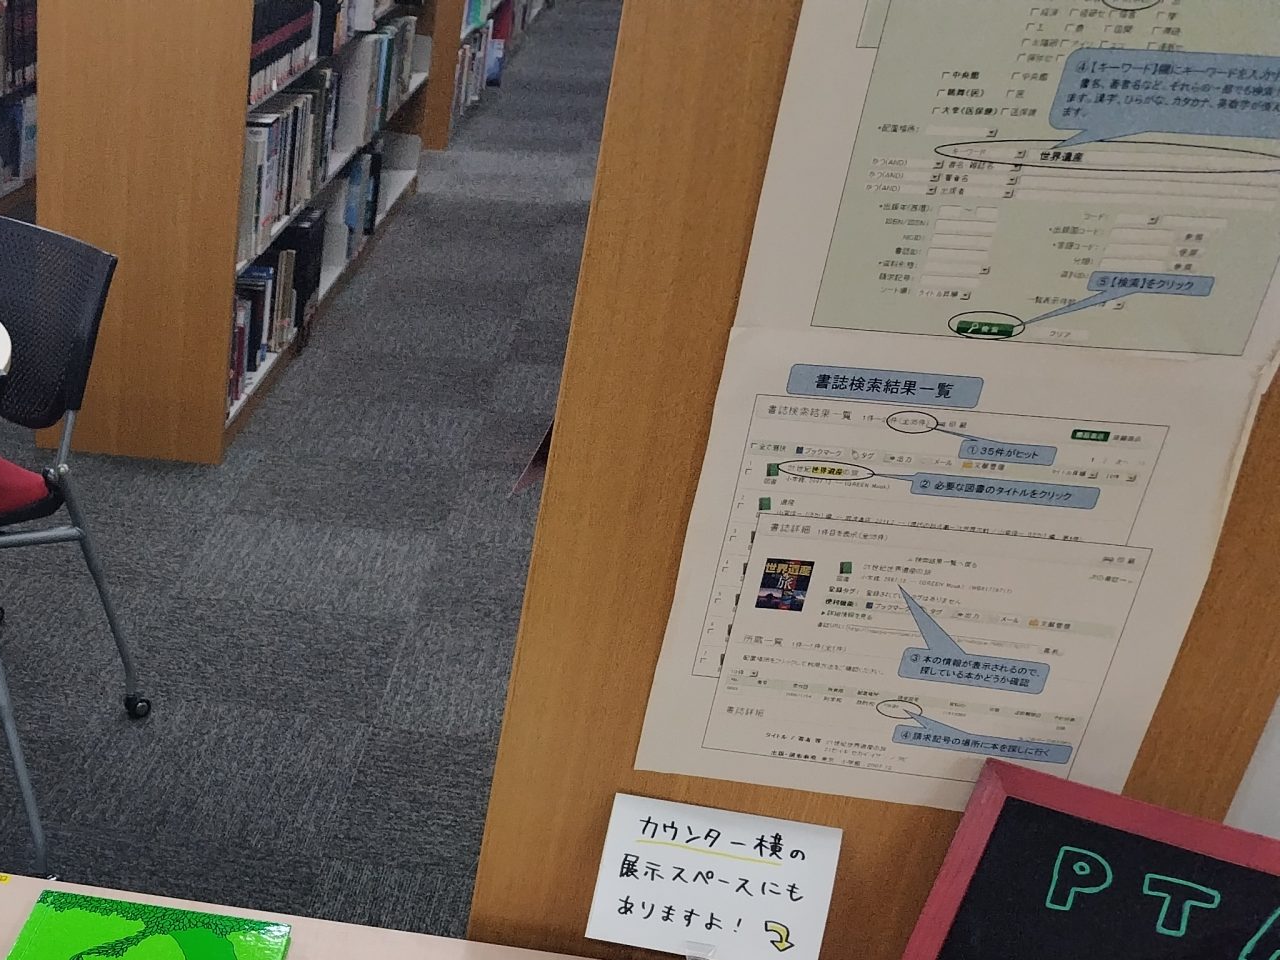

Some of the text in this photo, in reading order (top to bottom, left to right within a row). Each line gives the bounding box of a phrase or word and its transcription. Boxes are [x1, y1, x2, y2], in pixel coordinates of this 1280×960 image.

[814, 372, 955, 399] 書誌検索結果一覧
[639, 815, 807, 863] カウンター横の
[618, 852, 806, 903] 展示スペースにも
